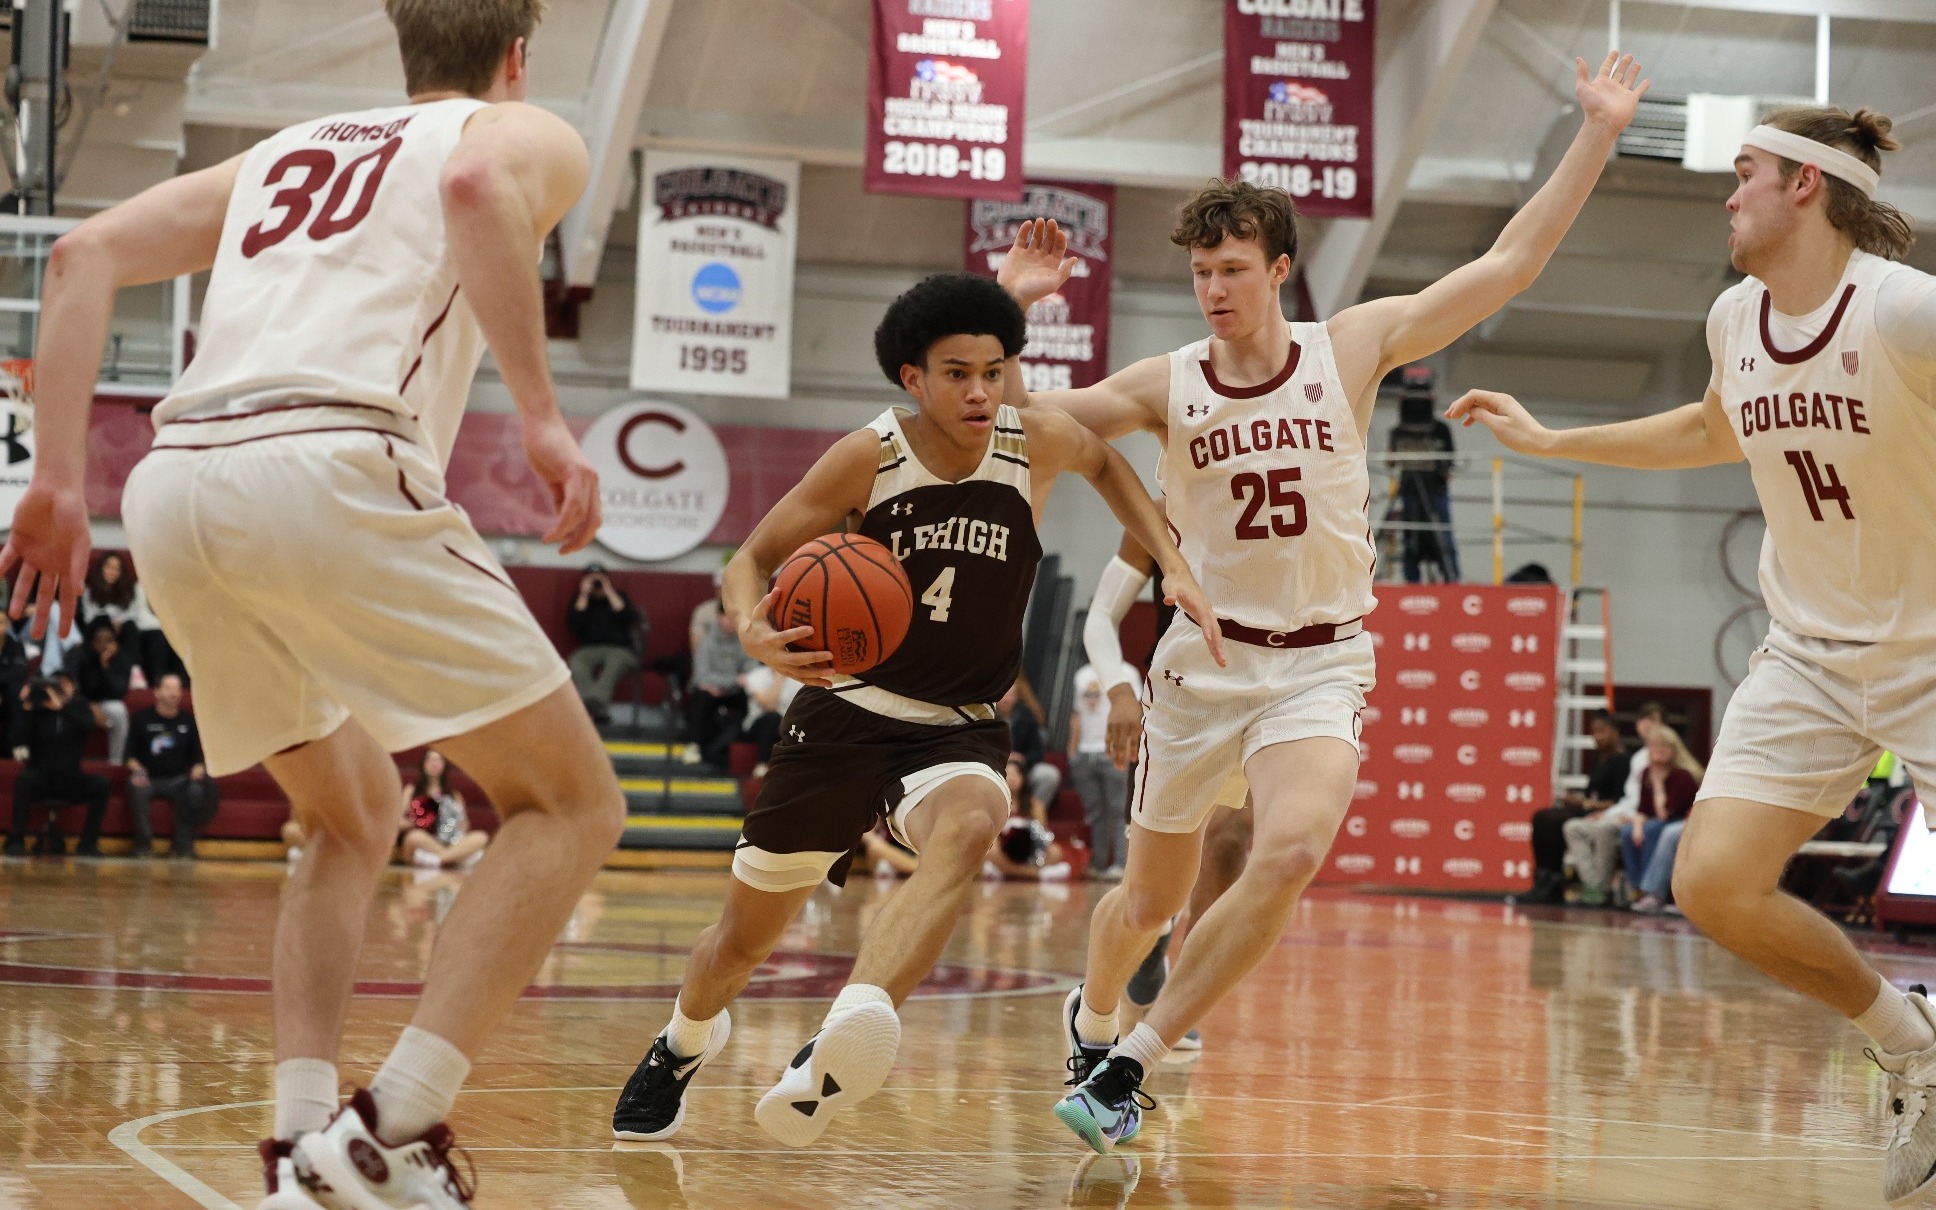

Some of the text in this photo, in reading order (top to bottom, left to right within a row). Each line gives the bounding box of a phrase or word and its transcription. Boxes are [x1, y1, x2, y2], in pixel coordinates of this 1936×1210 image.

[883, 141, 1006, 181] 2018-19
[241, 136, 403, 259] 30
[652, 314, 777, 342] TOURNAMENT
[680, 344, 747, 375] 1995
[1740, 392, 1871, 437] COLGATE
[617, 412, 686, 480] C
[1189, 418, 1335, 470] COLGATE
[1230, 467, 1308, 540] 25
[1783, 451, 1856, 521] 14
[890, 516, 1010, 562] LEHIGH
[921, 566, 956, 623] 4
[1267, 631, 1286, 647] C
